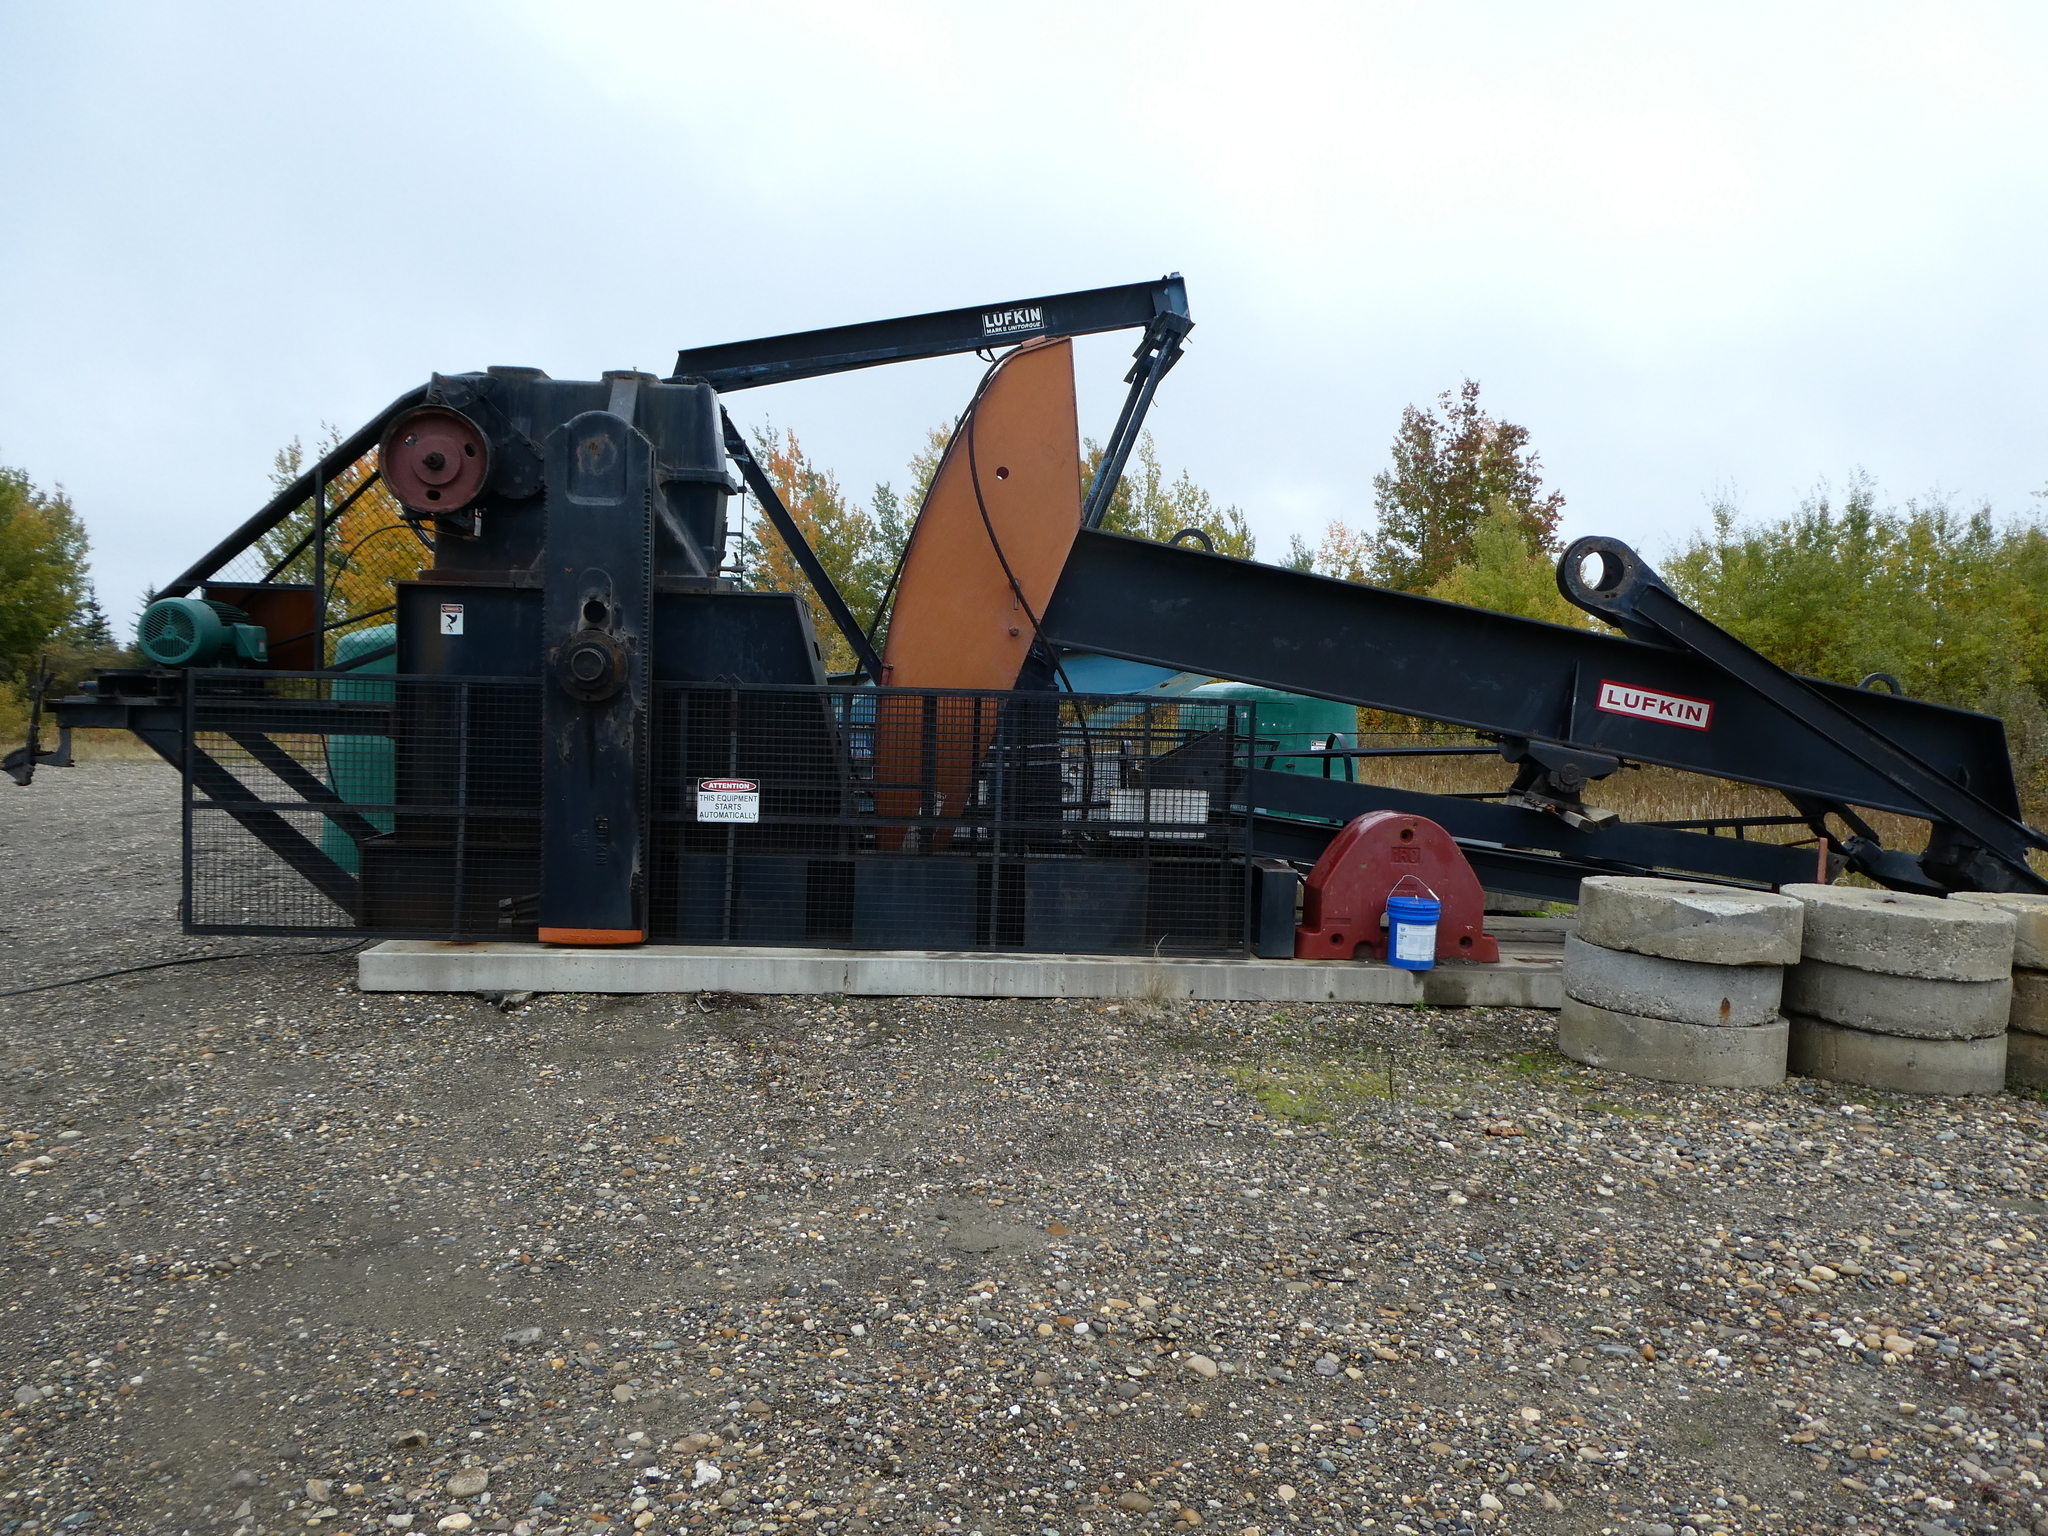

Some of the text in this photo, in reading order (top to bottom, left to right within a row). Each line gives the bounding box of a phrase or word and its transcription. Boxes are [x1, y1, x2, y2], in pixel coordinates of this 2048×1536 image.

[985, 308, 1041, 328] LUFKIN
[1008, 321, 1041, 331] UNITORQUE
[1607, 689, 1702, 722] LUFKIN
[715, 803, 742, 811] STARTS
[699, 811, 757, 819] AUTOMATICALLY
